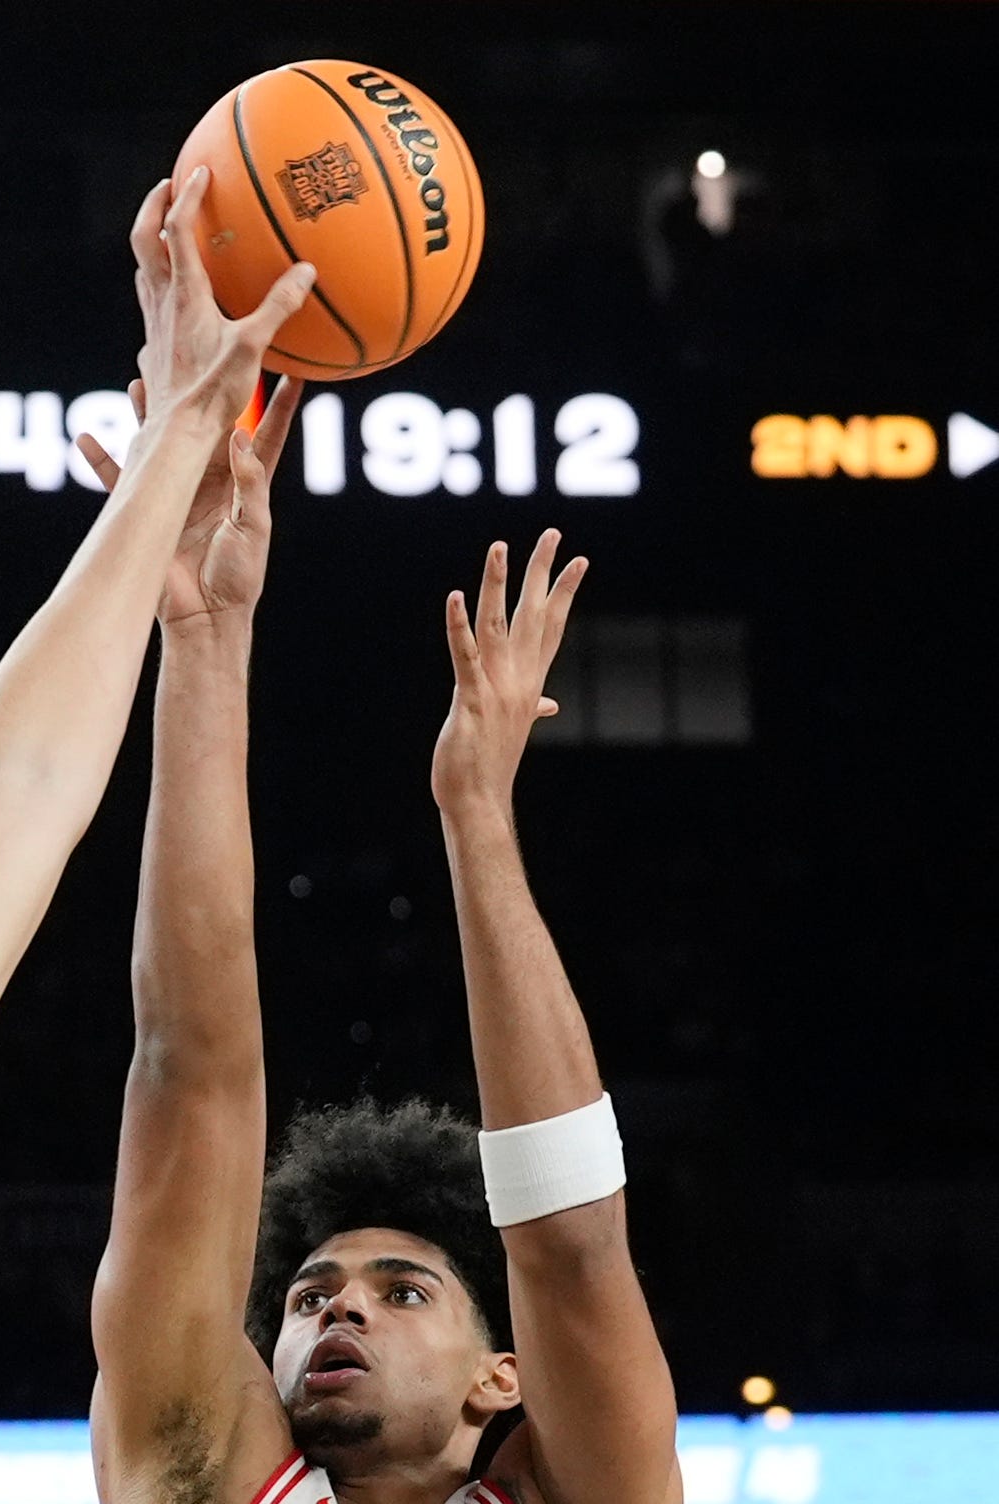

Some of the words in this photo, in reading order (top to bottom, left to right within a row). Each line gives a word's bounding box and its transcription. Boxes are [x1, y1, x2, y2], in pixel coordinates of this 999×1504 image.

[291, 167, 321, 209] FOUR
[321, 151, 353, 196] FINAL
[347, 71, 449, 257] Wilson
[302, 392, 640, 496] 19:12
[751, 414, 937, 478] 2ND
